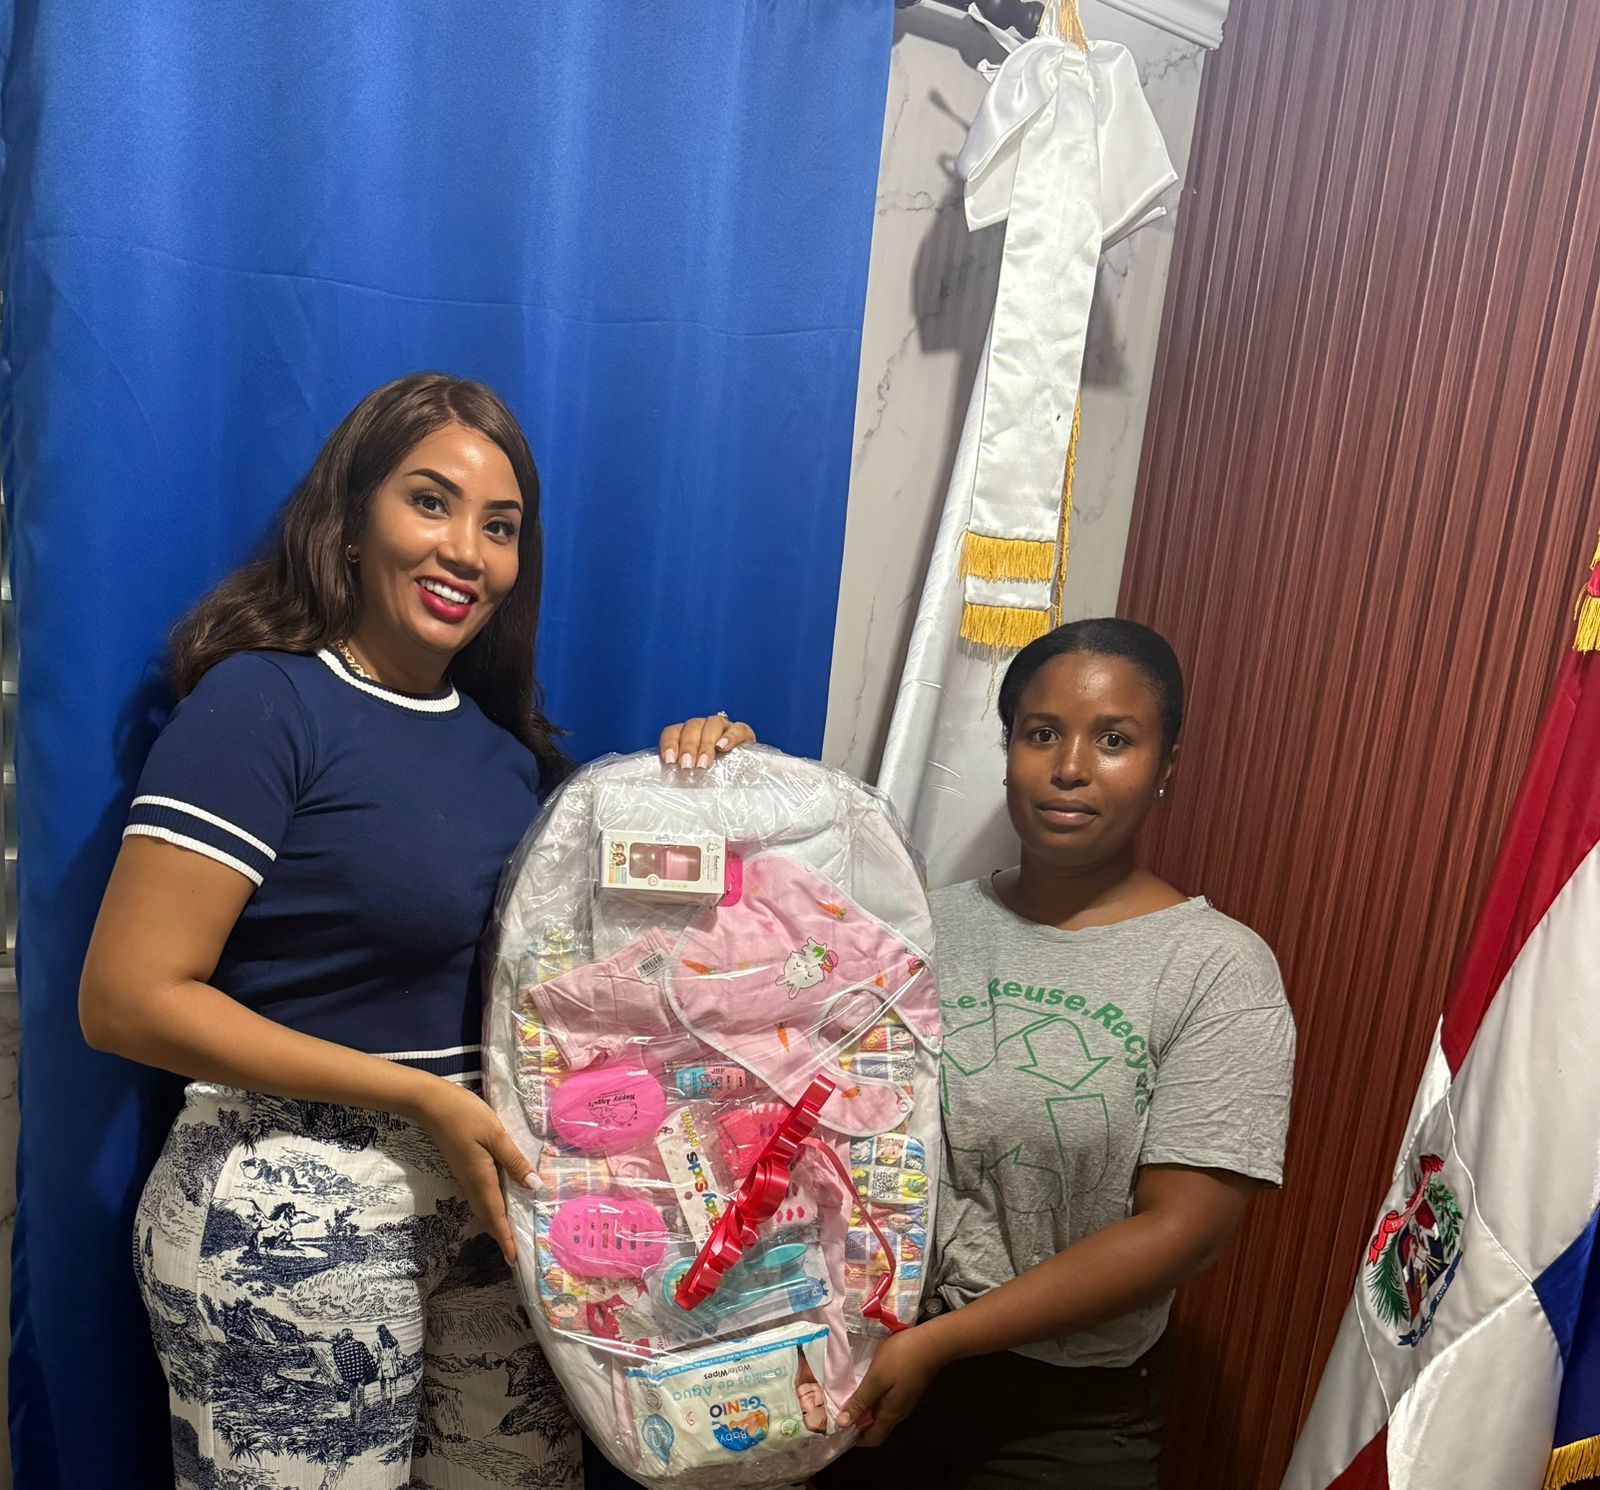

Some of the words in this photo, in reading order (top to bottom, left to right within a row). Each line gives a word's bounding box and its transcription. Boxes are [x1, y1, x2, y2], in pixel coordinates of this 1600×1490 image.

[672, 1383, 713, 1402] Agua
[717, 1380, 734, 1391] de
[709, 1395, 762, 1419] GENIO
[720, 1430, 747, 1442] Baby
